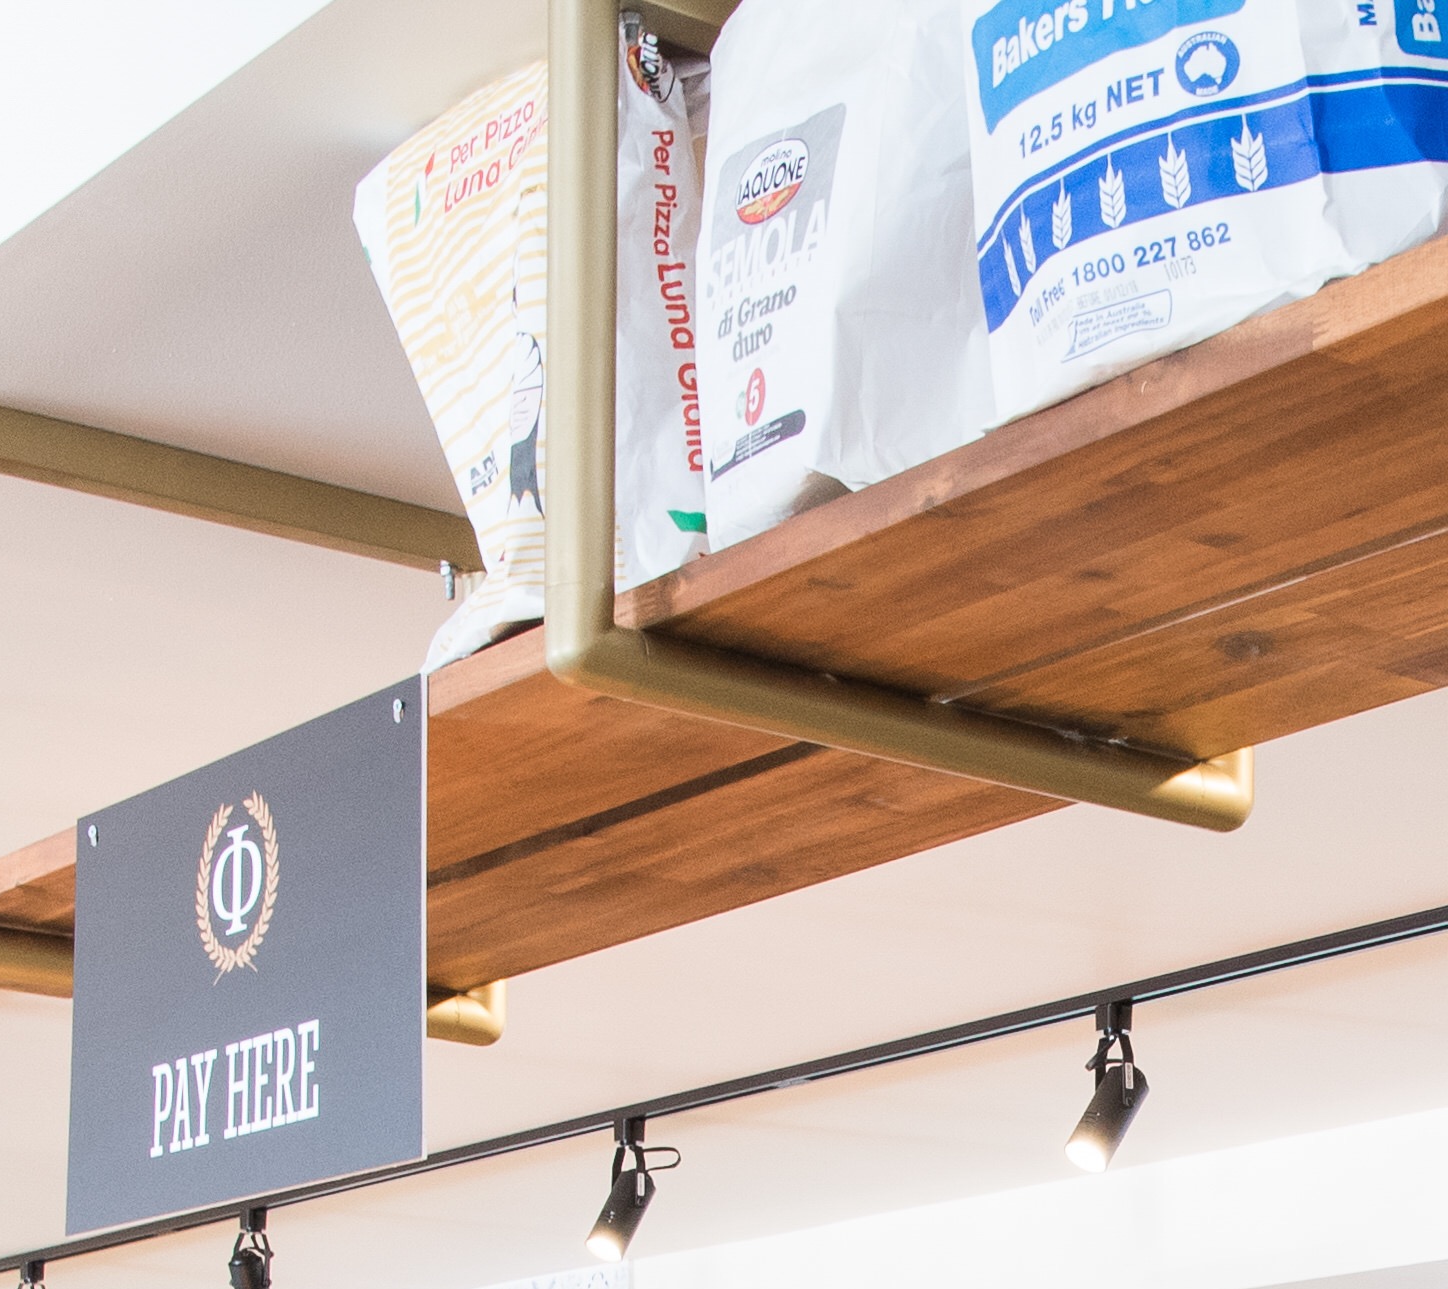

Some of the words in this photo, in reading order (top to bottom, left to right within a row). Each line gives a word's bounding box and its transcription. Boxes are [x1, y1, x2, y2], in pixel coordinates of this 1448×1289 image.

[992, 0, 1089, 89] Bakers
[448, 137, 475, 175] Per
[483, 98, 536, 151] Pizza
[1019, 113, 1063, 159] 12.5
[1071, 100, 1098, 132] kg
[1106, 67, 1165, 113] NET
[443, 158, 502, 214] Luna
[651, 129, 674, 176] Per
[737, 155, 806, 206] IAQUONE
[653, 183, 678, 257] Pizza
[1071, 252, 1126, 288] 1800
[1133, 235, 1178, 269] 227
[1186, 221, 1232, 252] 862
[657, 261, 696, 351] Luna
[717, 305, 734, 340] di
[737, 284, 797, 328] Grano
[732, 322, 773, 363] duro
[150, 1047, 217, 1158] PAY
[222, 1018, 320, 1140] HERE
